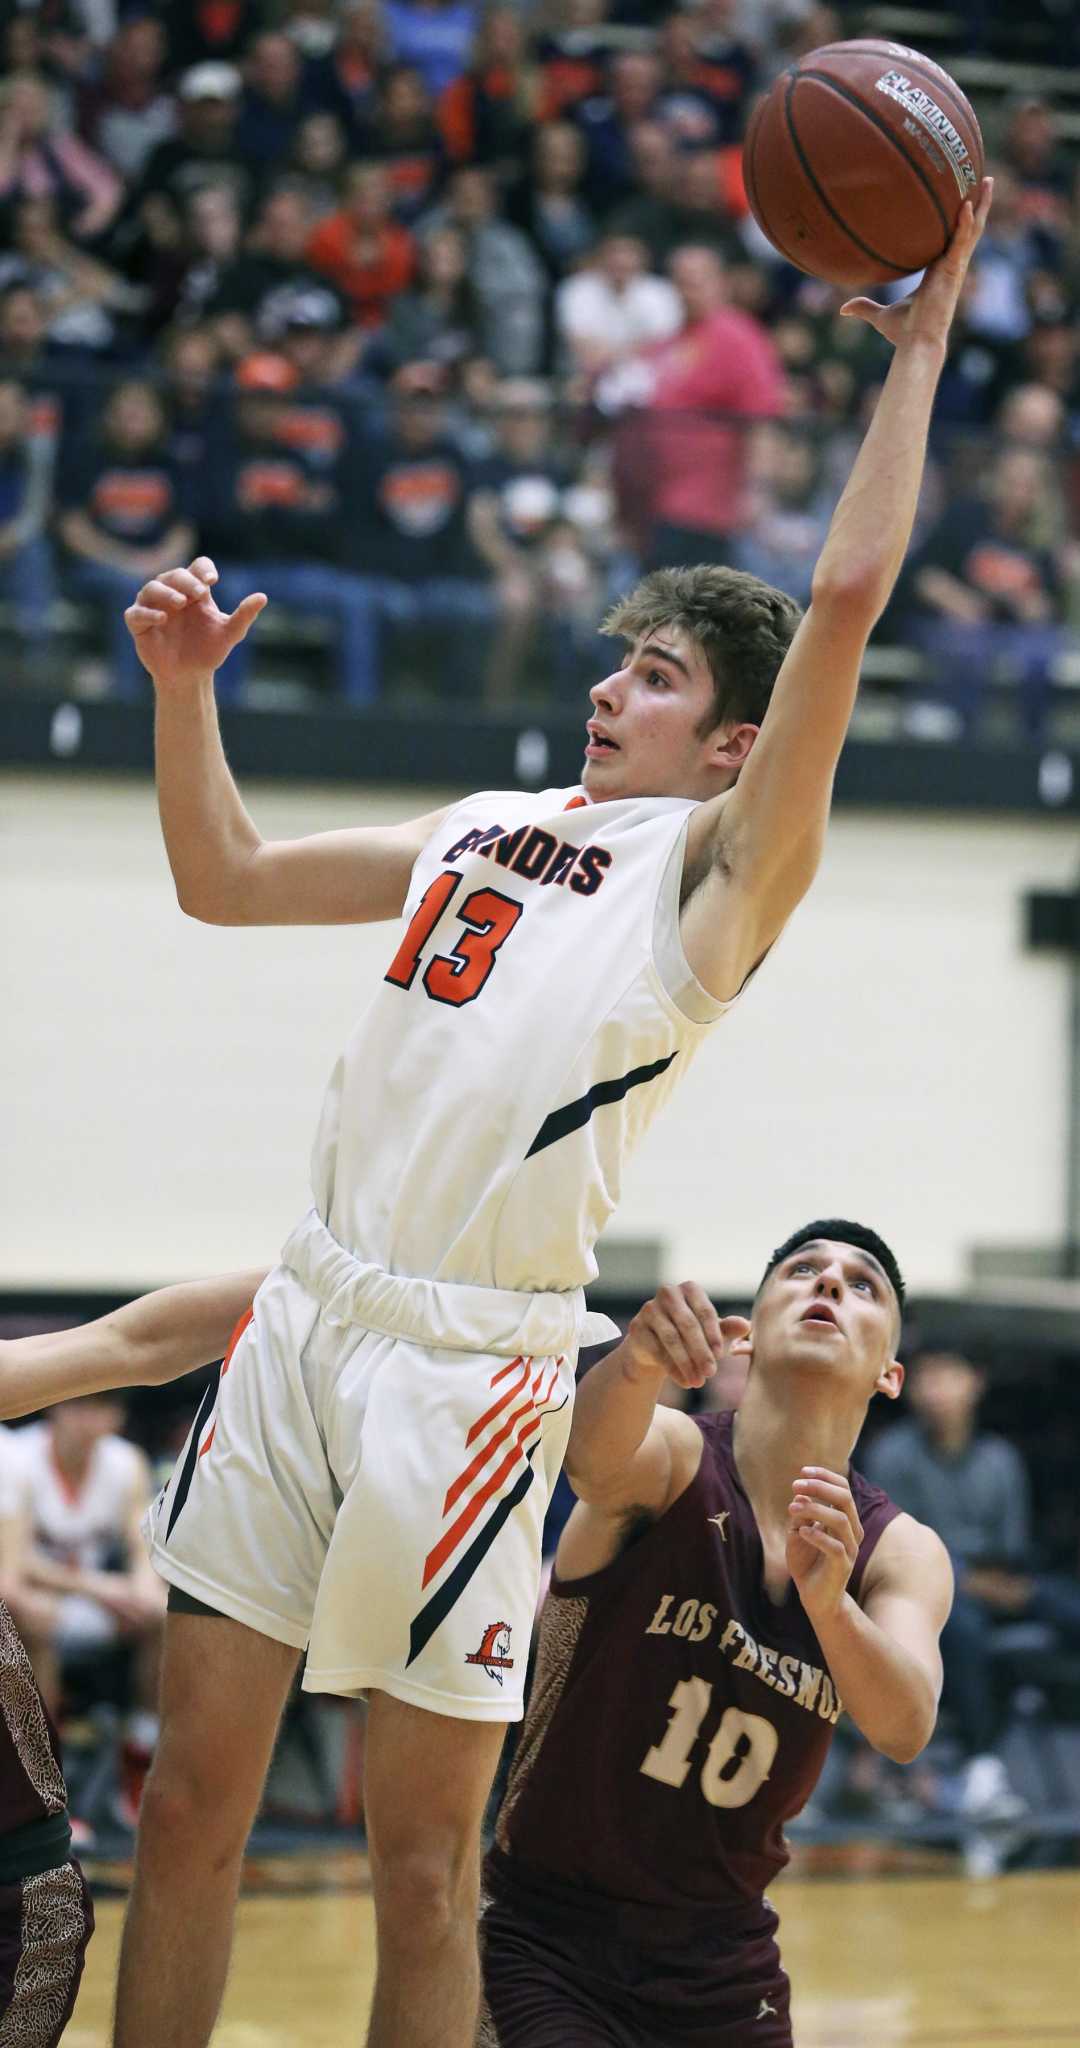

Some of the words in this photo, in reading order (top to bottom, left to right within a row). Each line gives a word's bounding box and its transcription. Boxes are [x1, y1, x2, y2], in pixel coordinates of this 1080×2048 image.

[877, 70, 968, 161] PLATINUM
[384, 870, 523, 1008] 13
[645, 1595, 718, 1641] LOS
[640, 1675, 778, 1808] 10
